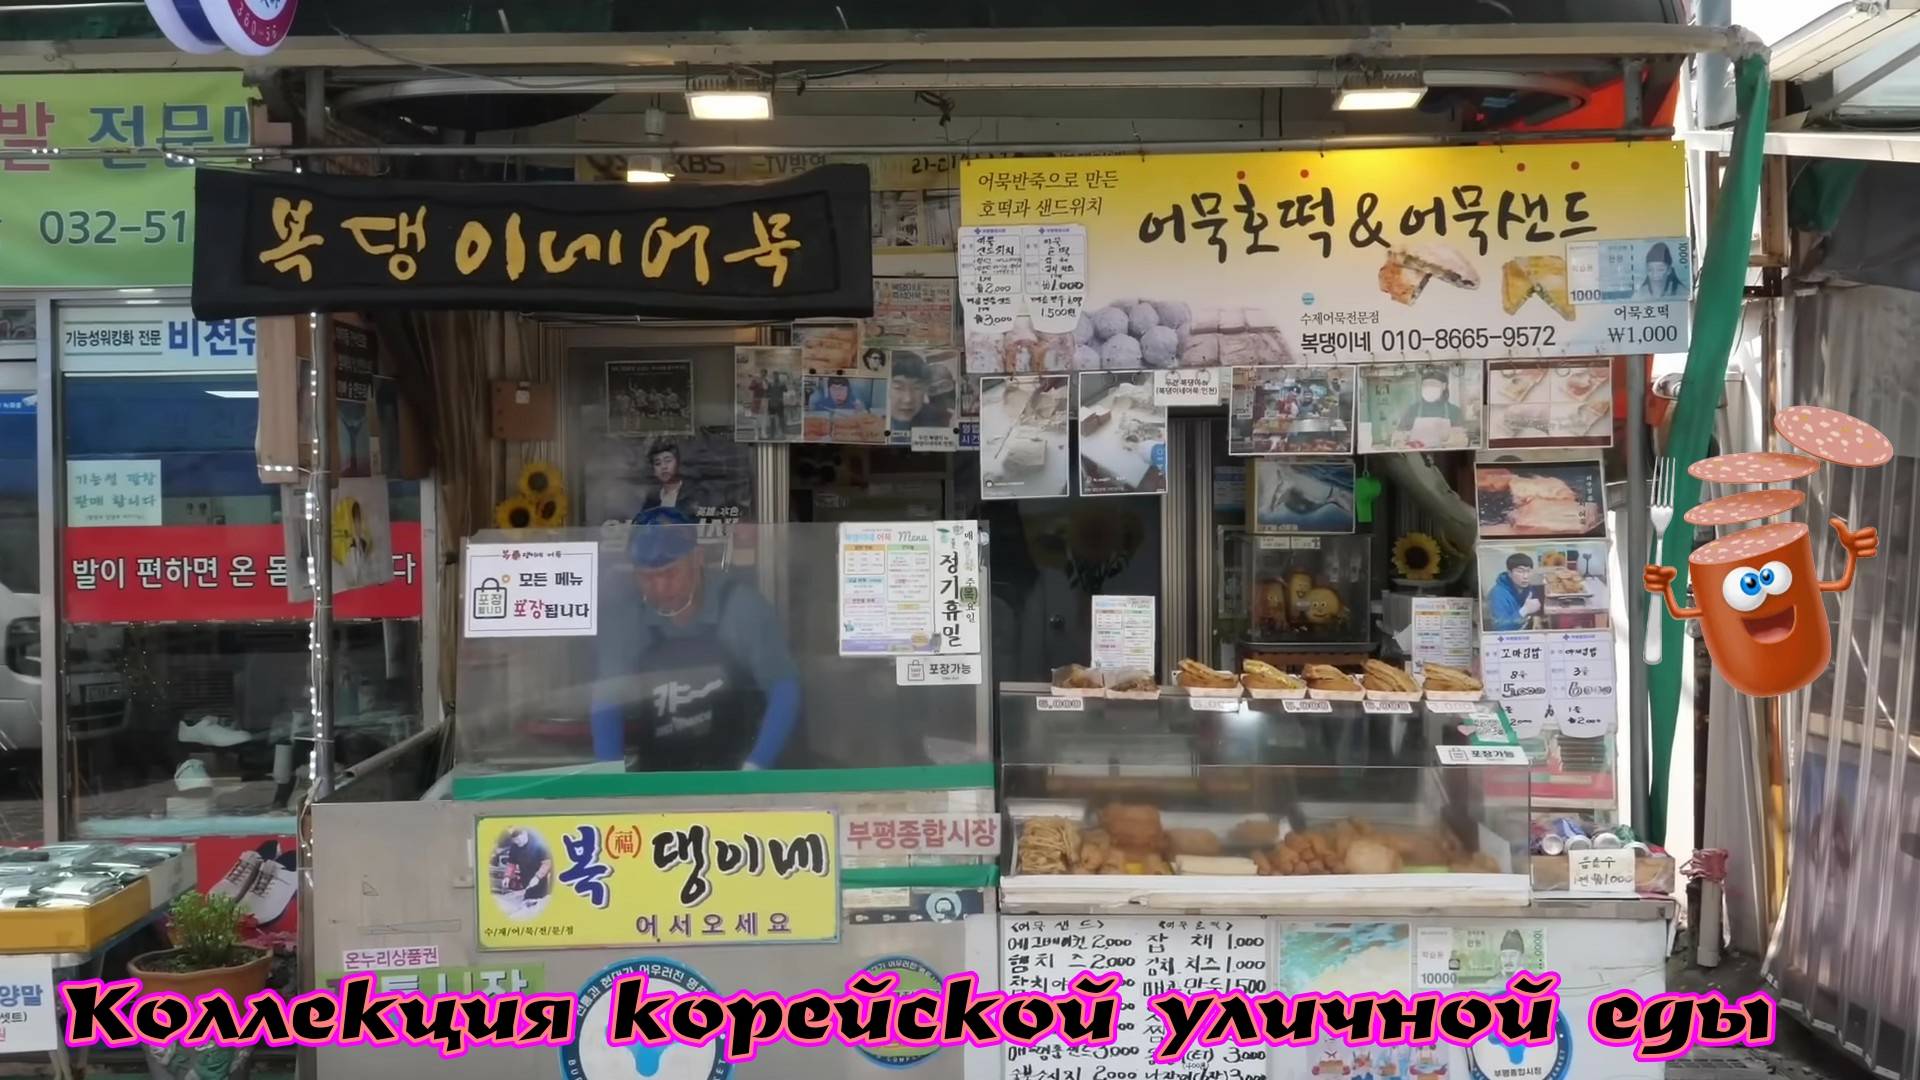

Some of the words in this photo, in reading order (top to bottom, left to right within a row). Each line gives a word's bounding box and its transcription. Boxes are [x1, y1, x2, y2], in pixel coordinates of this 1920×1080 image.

[978, 171, 1080, 191] 어묵반죽으로
[1085, 169, 1119, 189] 만든
[978, 199, 1031, 218] 호떡과
[1036, 197, 1103, 217] 샌드위치
[40, 209, 188, 245] 032-51
[1301, 311, 1379, 325] 수제어묵전문점
[1614, 304, 1670, 320] 어묵호떡
[66, 330, 134, 347] 기능성워킹화
[138, 330, 162, 347] 전문
[1301, 331, 1371, 354] 복댕이네
[1381, 326, 1556, 351] 010-8665-9572
[72, 557, 125, 589] 발이
[137, 557, 218, 589] 편하면
[228, 556, 257, 587] 온
[519, 572, 547, 587] 모든
[555, 572, 583, 586] 메뉴
[514, 600, 590, 619] 포장됩니다
[939, 551, 963, 648] 정기휴일
[929, 663, 971, 675] 포장가능
[847, 817, 997, 850] 부평종합시장
[344, 947, 437, 969] 온누리상품권
[1421, 972, 1458, 985] 10000
